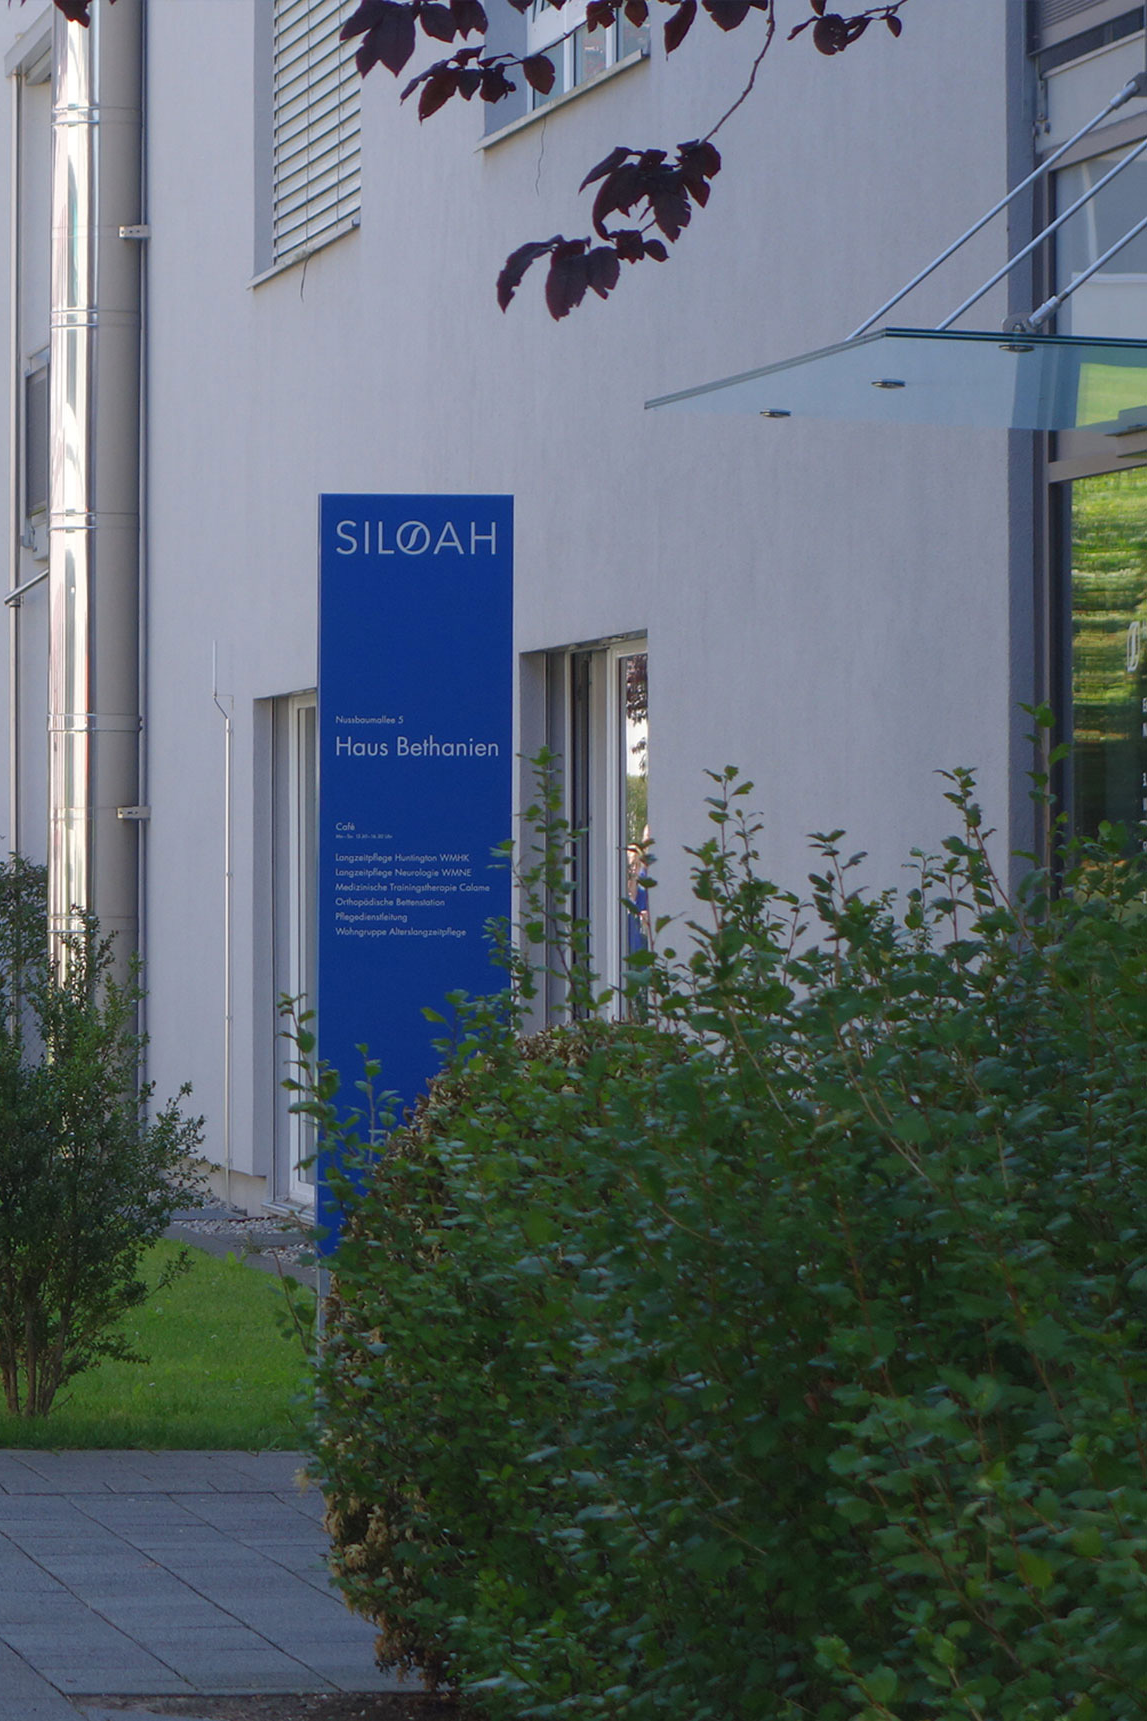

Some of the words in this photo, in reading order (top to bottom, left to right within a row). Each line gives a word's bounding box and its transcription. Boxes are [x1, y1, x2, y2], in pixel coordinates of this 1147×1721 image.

[335, 715, 396, 725] Nussbaumallee
[397, 715, 404, 725] 5
[335, 734, 389, 757] Haus
[396, 734, 499, 757] Bethanien
[335, 821, 355, 832] Café
[335, 852, 393, 864] Langzeitpflege
[394, 852, 438, 864] Huntington
[439, 852, 470, 863] WMHK
[335, 867, 393, 879] Langzeitpflege
[394, 867, 440, 879] Neurologie
[441, 867, 472, 878] WMNE
[335, 882, 388, 893] Medizinische
[389, 882, 458, 894] Trainingstherapie
[458, 882, 491, 893] Calame
[335, 897, 395, 908] Orthopädische
[395, 897, 446, 908] Bettenstation
[335, 911, 408, 924] Pflegedienstleitung
[335, 926, 388, 938] Wohngruppe
[388, 926, 468, 939] Alterslangzeitpflege
